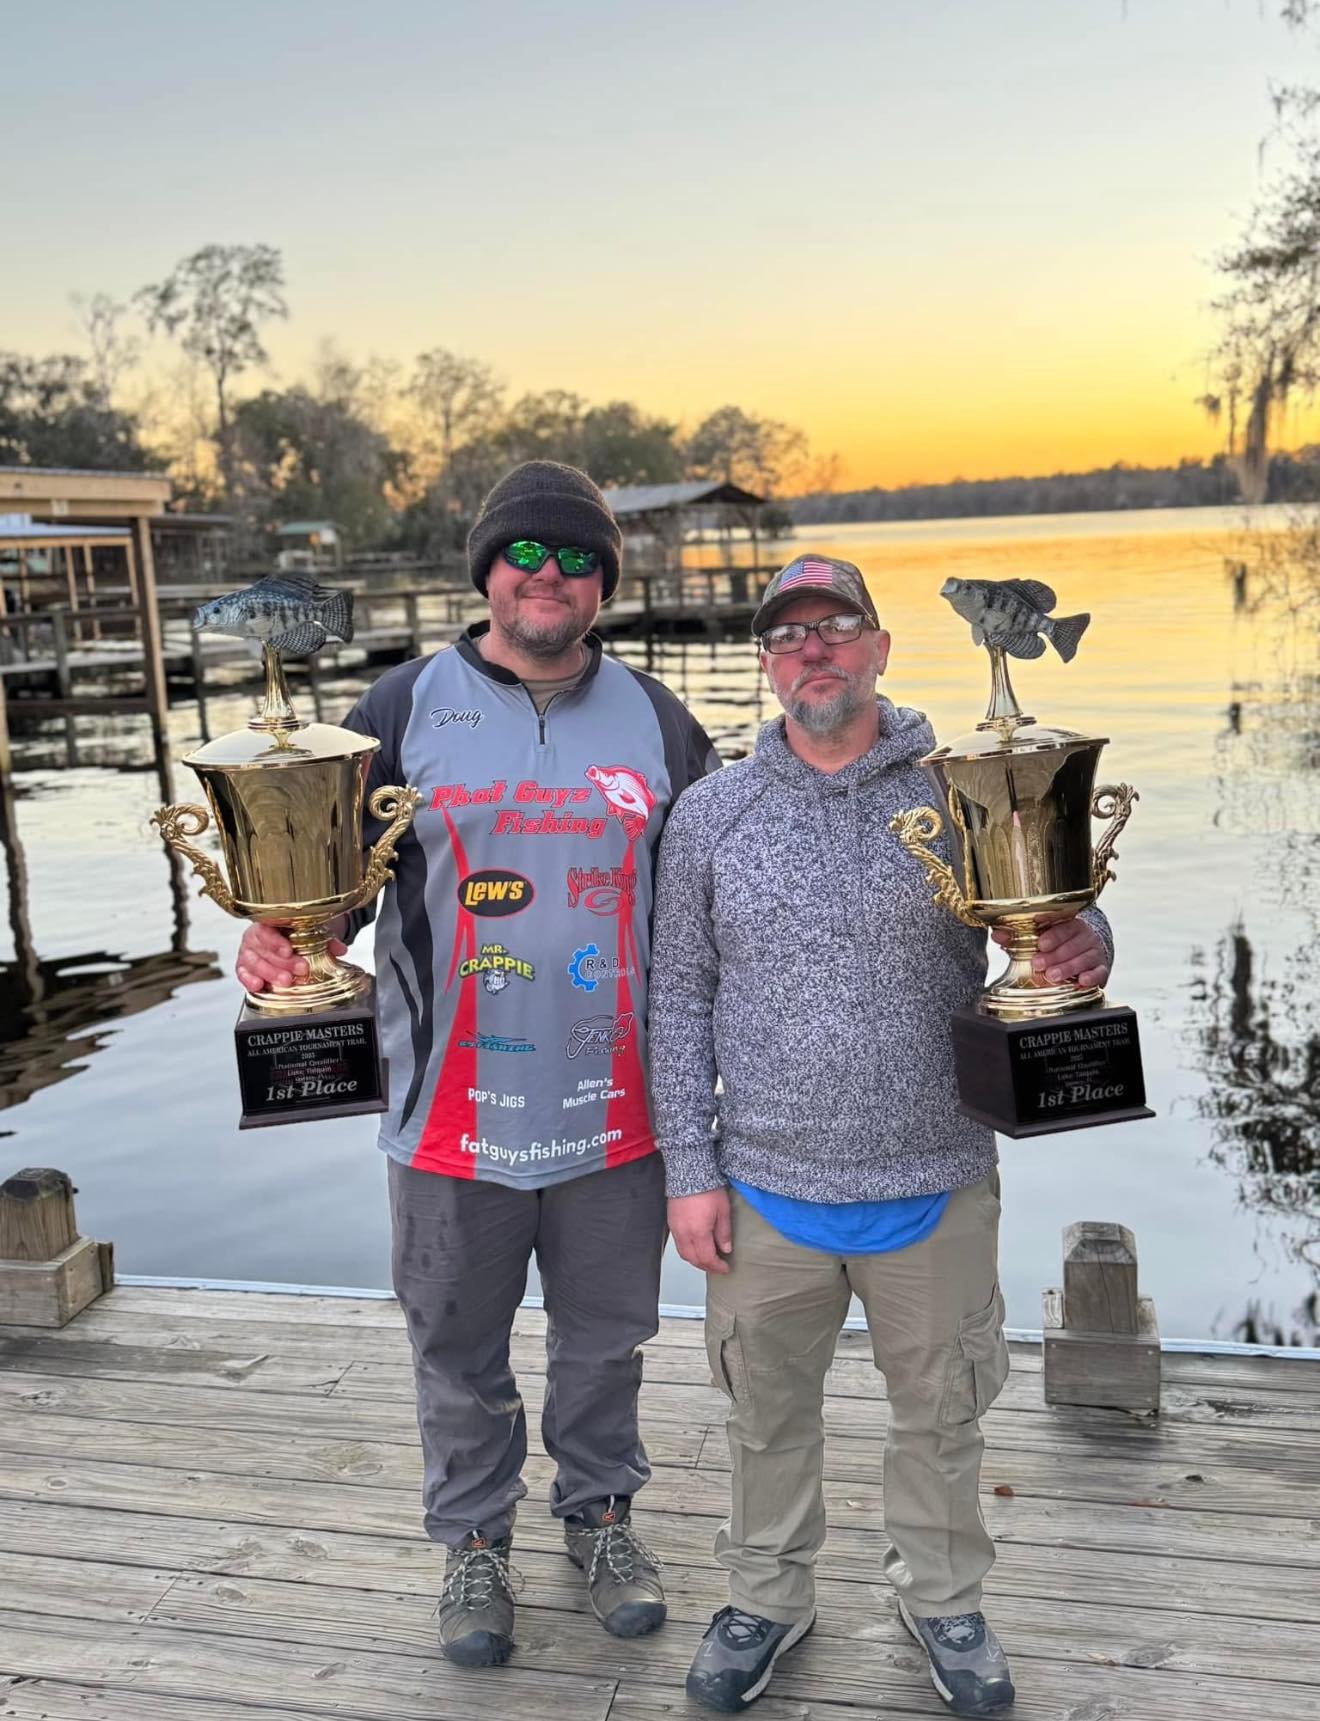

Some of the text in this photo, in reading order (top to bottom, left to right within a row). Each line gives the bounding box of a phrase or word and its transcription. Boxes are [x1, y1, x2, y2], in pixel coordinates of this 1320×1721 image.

[430, 707, 484, 729] Doug
[428, 780, 592, 811] Phat Guyz
[489, 809, 608, 839] Fishing
[481, 944, 508, 956] MR.
[458, 955, 536, 981] CRAPPIE
[586, 957, 620, 970] R & D
[247, 1023, 364, 1047] CRAPPIE MASTERS
[1019, 1022, 1129, 1049] CRAPPIE MASTERS
[247, 1049, 261, 1057] ALL
[262, 1045, 298, 1055] AMERICAN
[299, 1040, 345, 1051] TOURNAMENT
[266, 1080, 358, 1101] 1st Place
[577, 1077, 614, 1093] Allen's
[1037, 1083, 1124, 1108] 1st Place
[468, 1087, 525, 1109] POP'S JIGS
[562, 1087, 626, 1110] Muscle Cars
[459, 1128, 623, 1167] fatguysfishing.com
